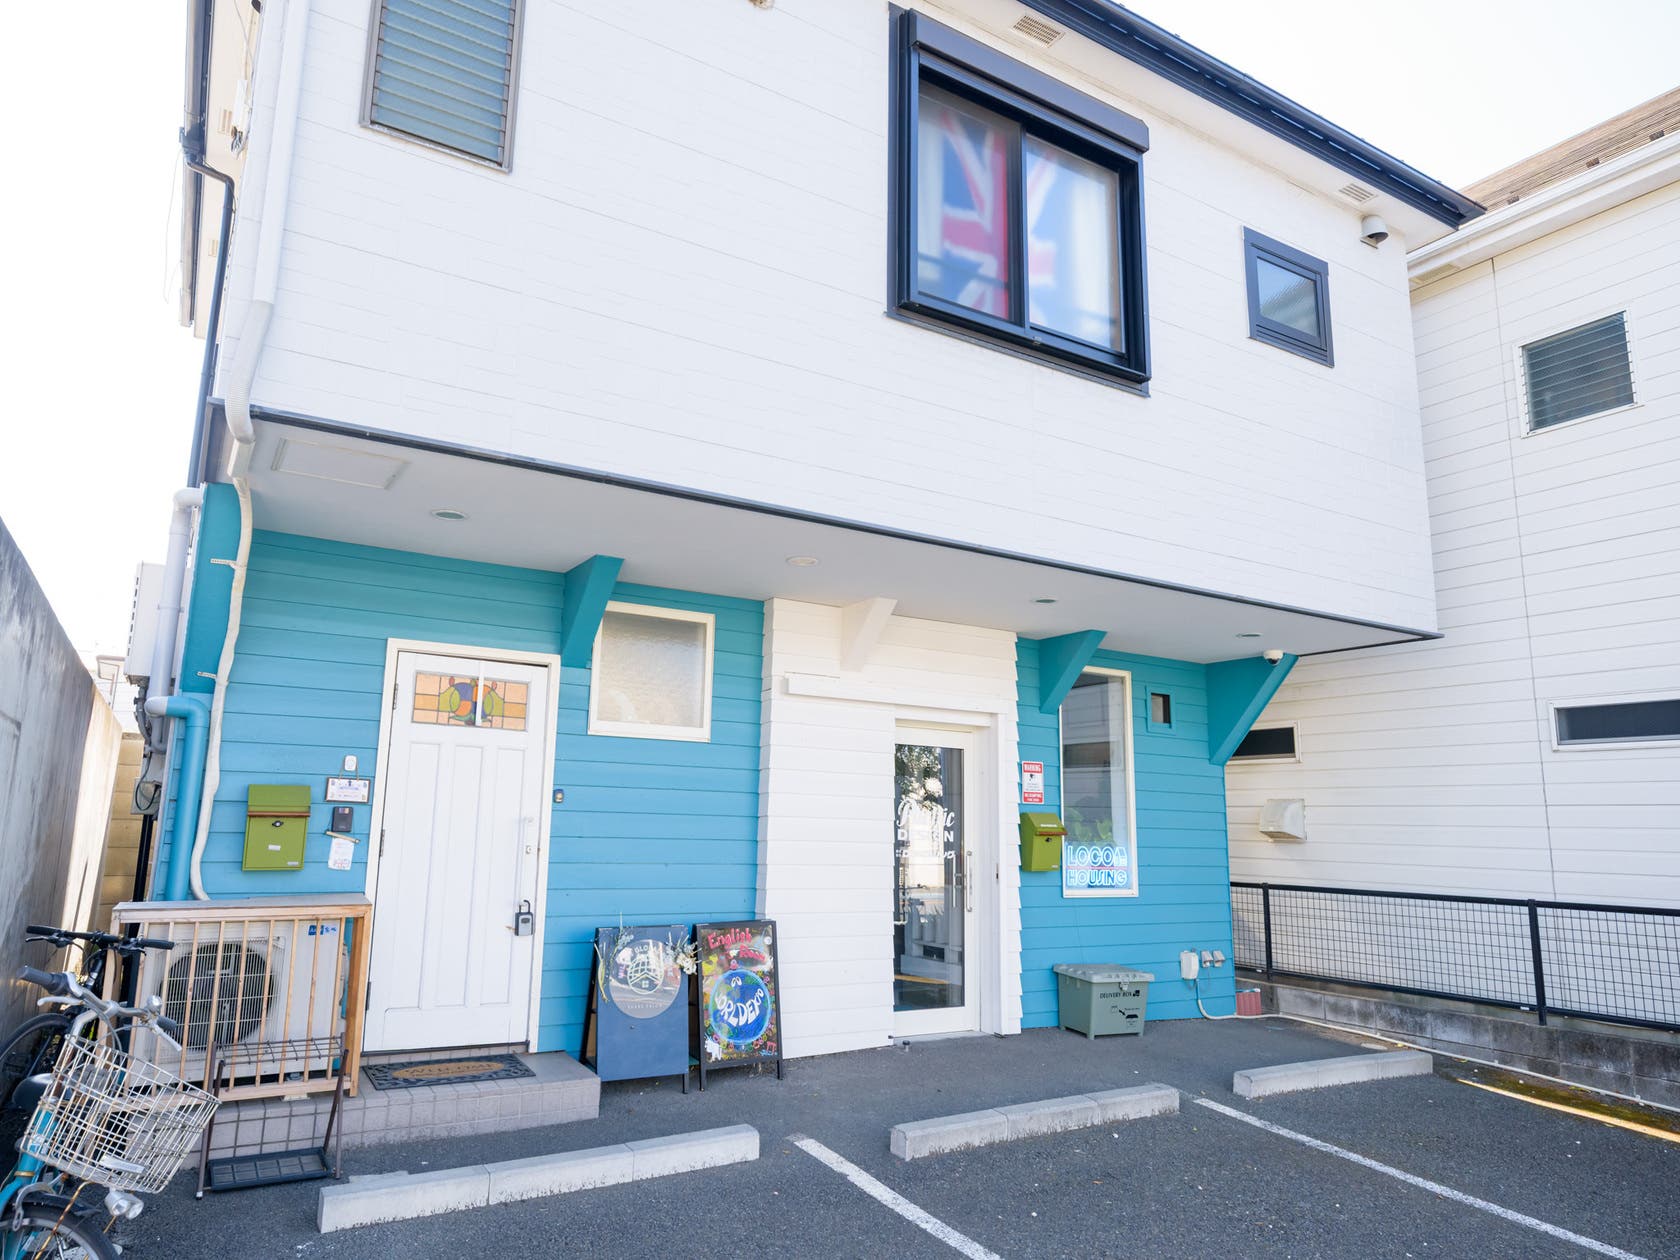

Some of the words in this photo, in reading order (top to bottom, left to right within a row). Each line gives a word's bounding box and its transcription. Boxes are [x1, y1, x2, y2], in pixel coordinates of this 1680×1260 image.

[1067, 845, 1114, 866] LOCO
[1067, 869, 1128, 886] HOUSING
[708, 927, 752, 949] English
